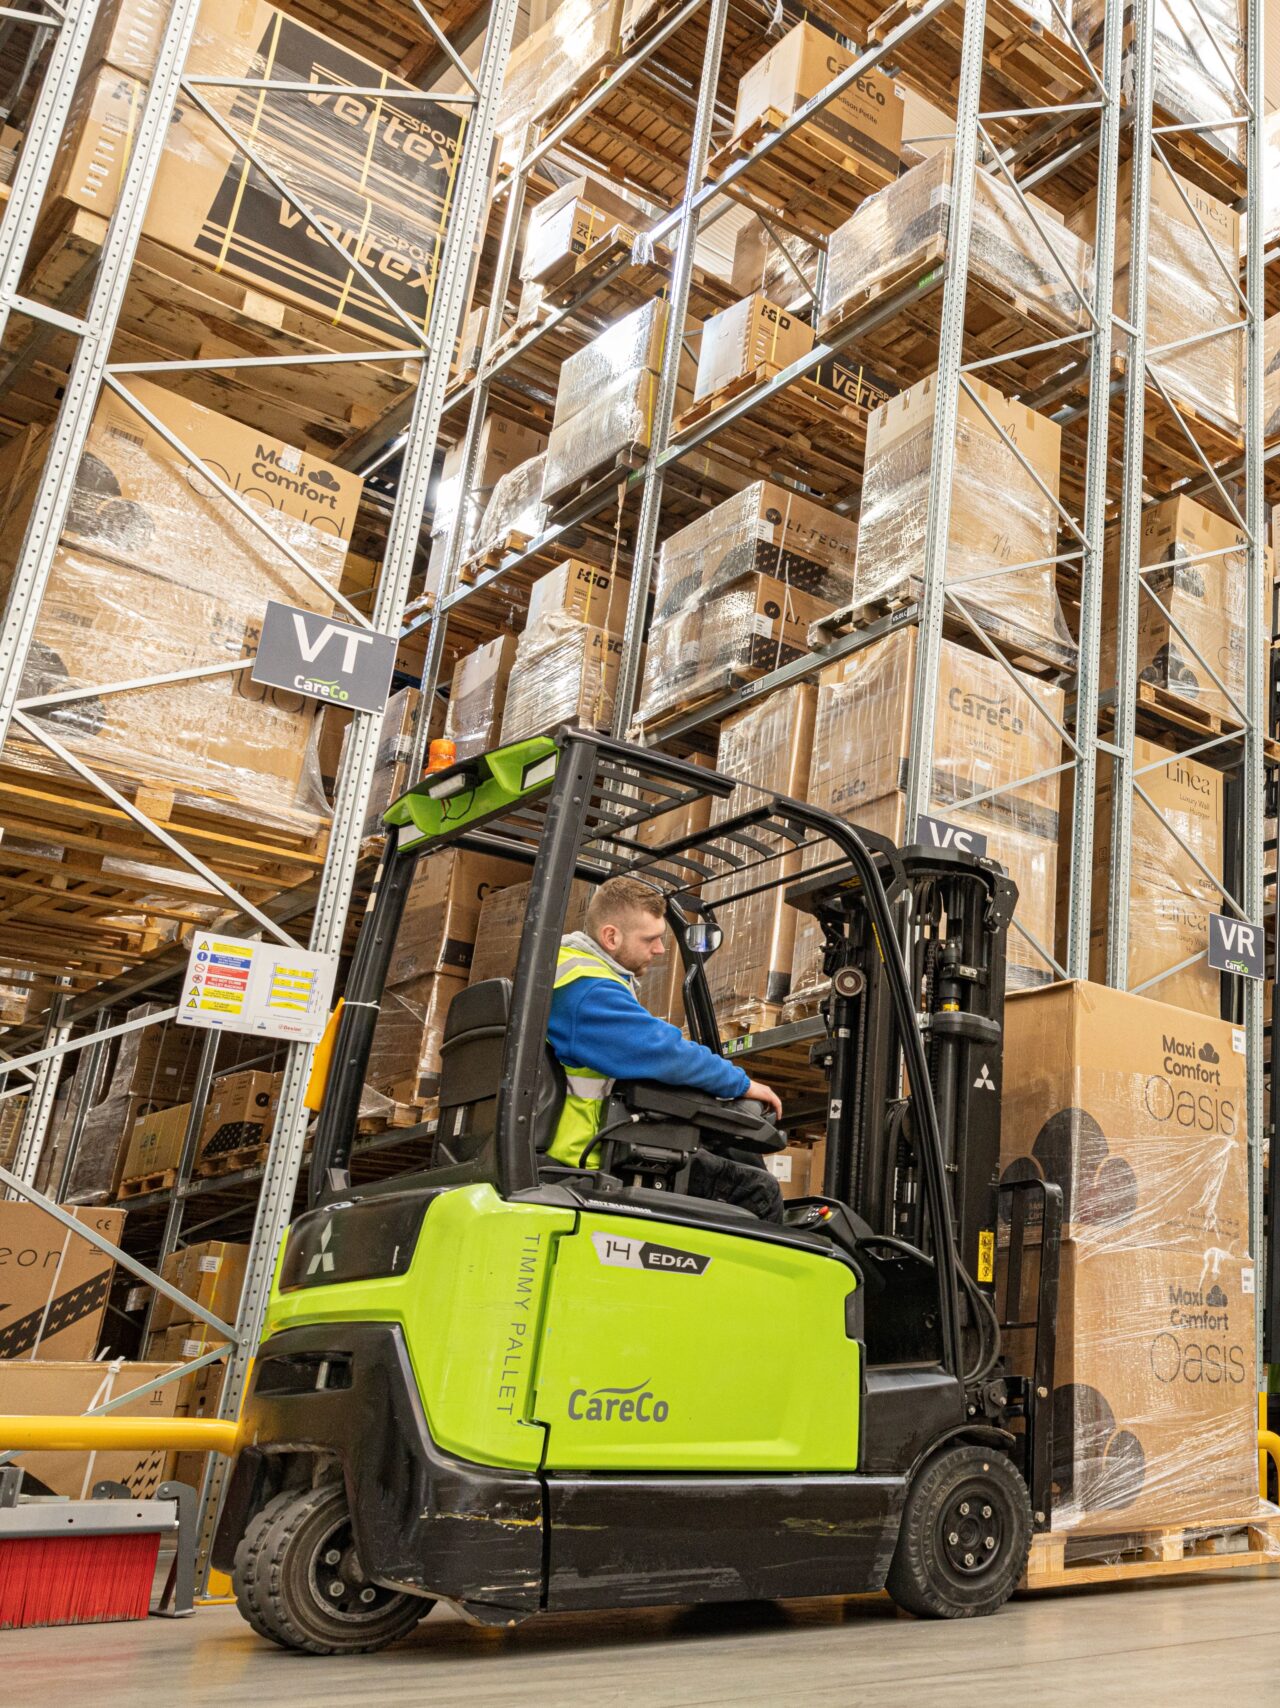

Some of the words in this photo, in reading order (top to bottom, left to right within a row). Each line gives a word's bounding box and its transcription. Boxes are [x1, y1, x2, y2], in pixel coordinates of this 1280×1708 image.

[826, 56, 885, 106] CaeCo
[1186, 187, 1229, 229] Linea
[832, 368, 886, 411] Vert
[255, 443, 306, 478] Mi
[251, 462, 338, 510] Comfort
[786, 518, 849, 553] LI-TECH
[292, 613, 374, 674] VT
[294, 674, 349, 702] CareCo
[948, 687, 1024, 736] CareCo
[831, 779, 866, 805] CareCo
[1166, 762, 1210, 796] Linea
[929, 821, 974, 854] VS
[1161, 895, 1207, 932] Linea
[1218, 919, 1256, 958] VR
[1225, 959, 1249, 974] CareCo
[1162, 1034, 1196, 1059] Maxi
[1163, 1056, 1221, 1086] Comfort
[1144, 1074, 1236, 1136] Oasis
[96, 1219, 111, 1231] CE
[605, 1239, 631, 1261] 14
[513, 1233, 541, 1311] TIMMY
[1169, 1284, 1203, 1306] Maxi
[1169, 1308, 1229, 1331] Comfort
[496, 1322, 527, 1416] PALLET
[1150, 1331, 1246, 1384] Oasis
[567, 1376, 670, 1423] CareCo
